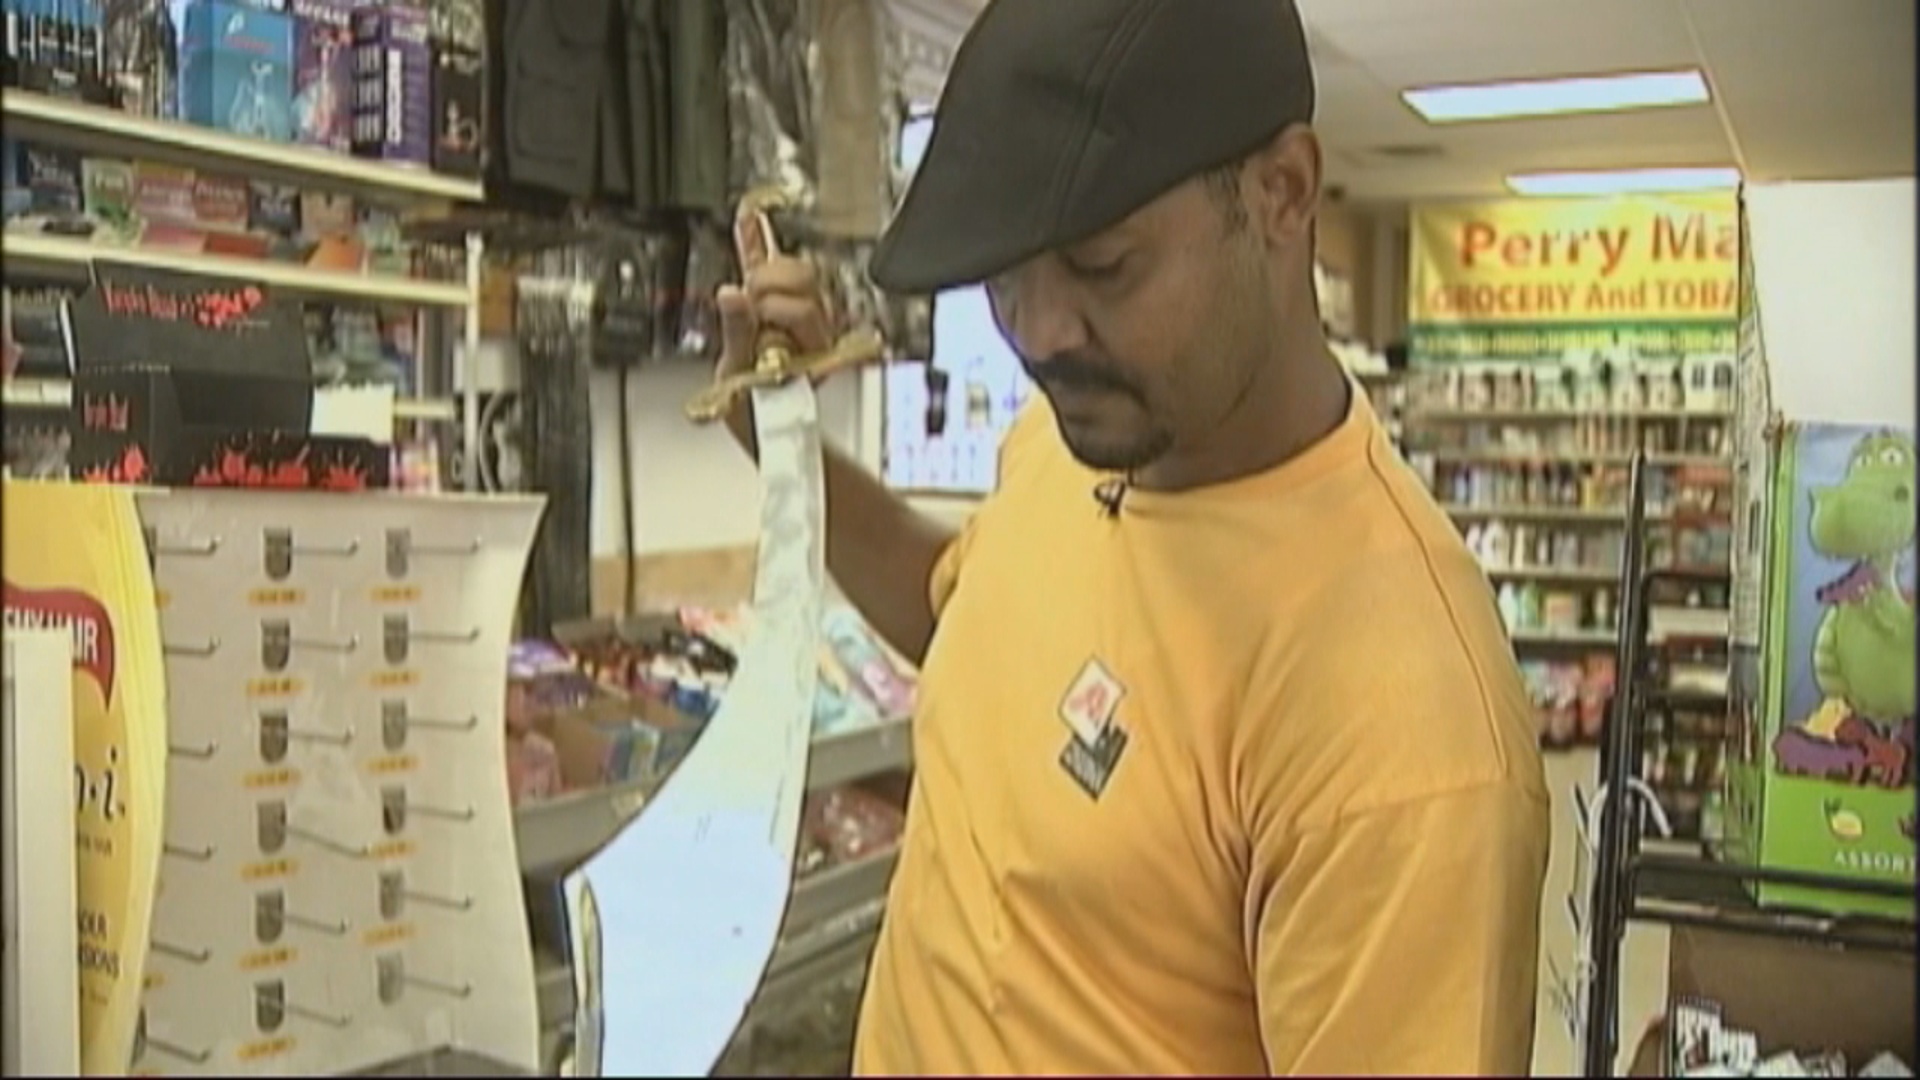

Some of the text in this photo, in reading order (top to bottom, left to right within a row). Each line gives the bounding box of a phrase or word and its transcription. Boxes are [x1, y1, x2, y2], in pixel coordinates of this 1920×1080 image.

[1459, 220, 1630, 278] Perry
[1428, 281, 1578, 315] GROCERY
[1586, 281, 1647, 311] And
